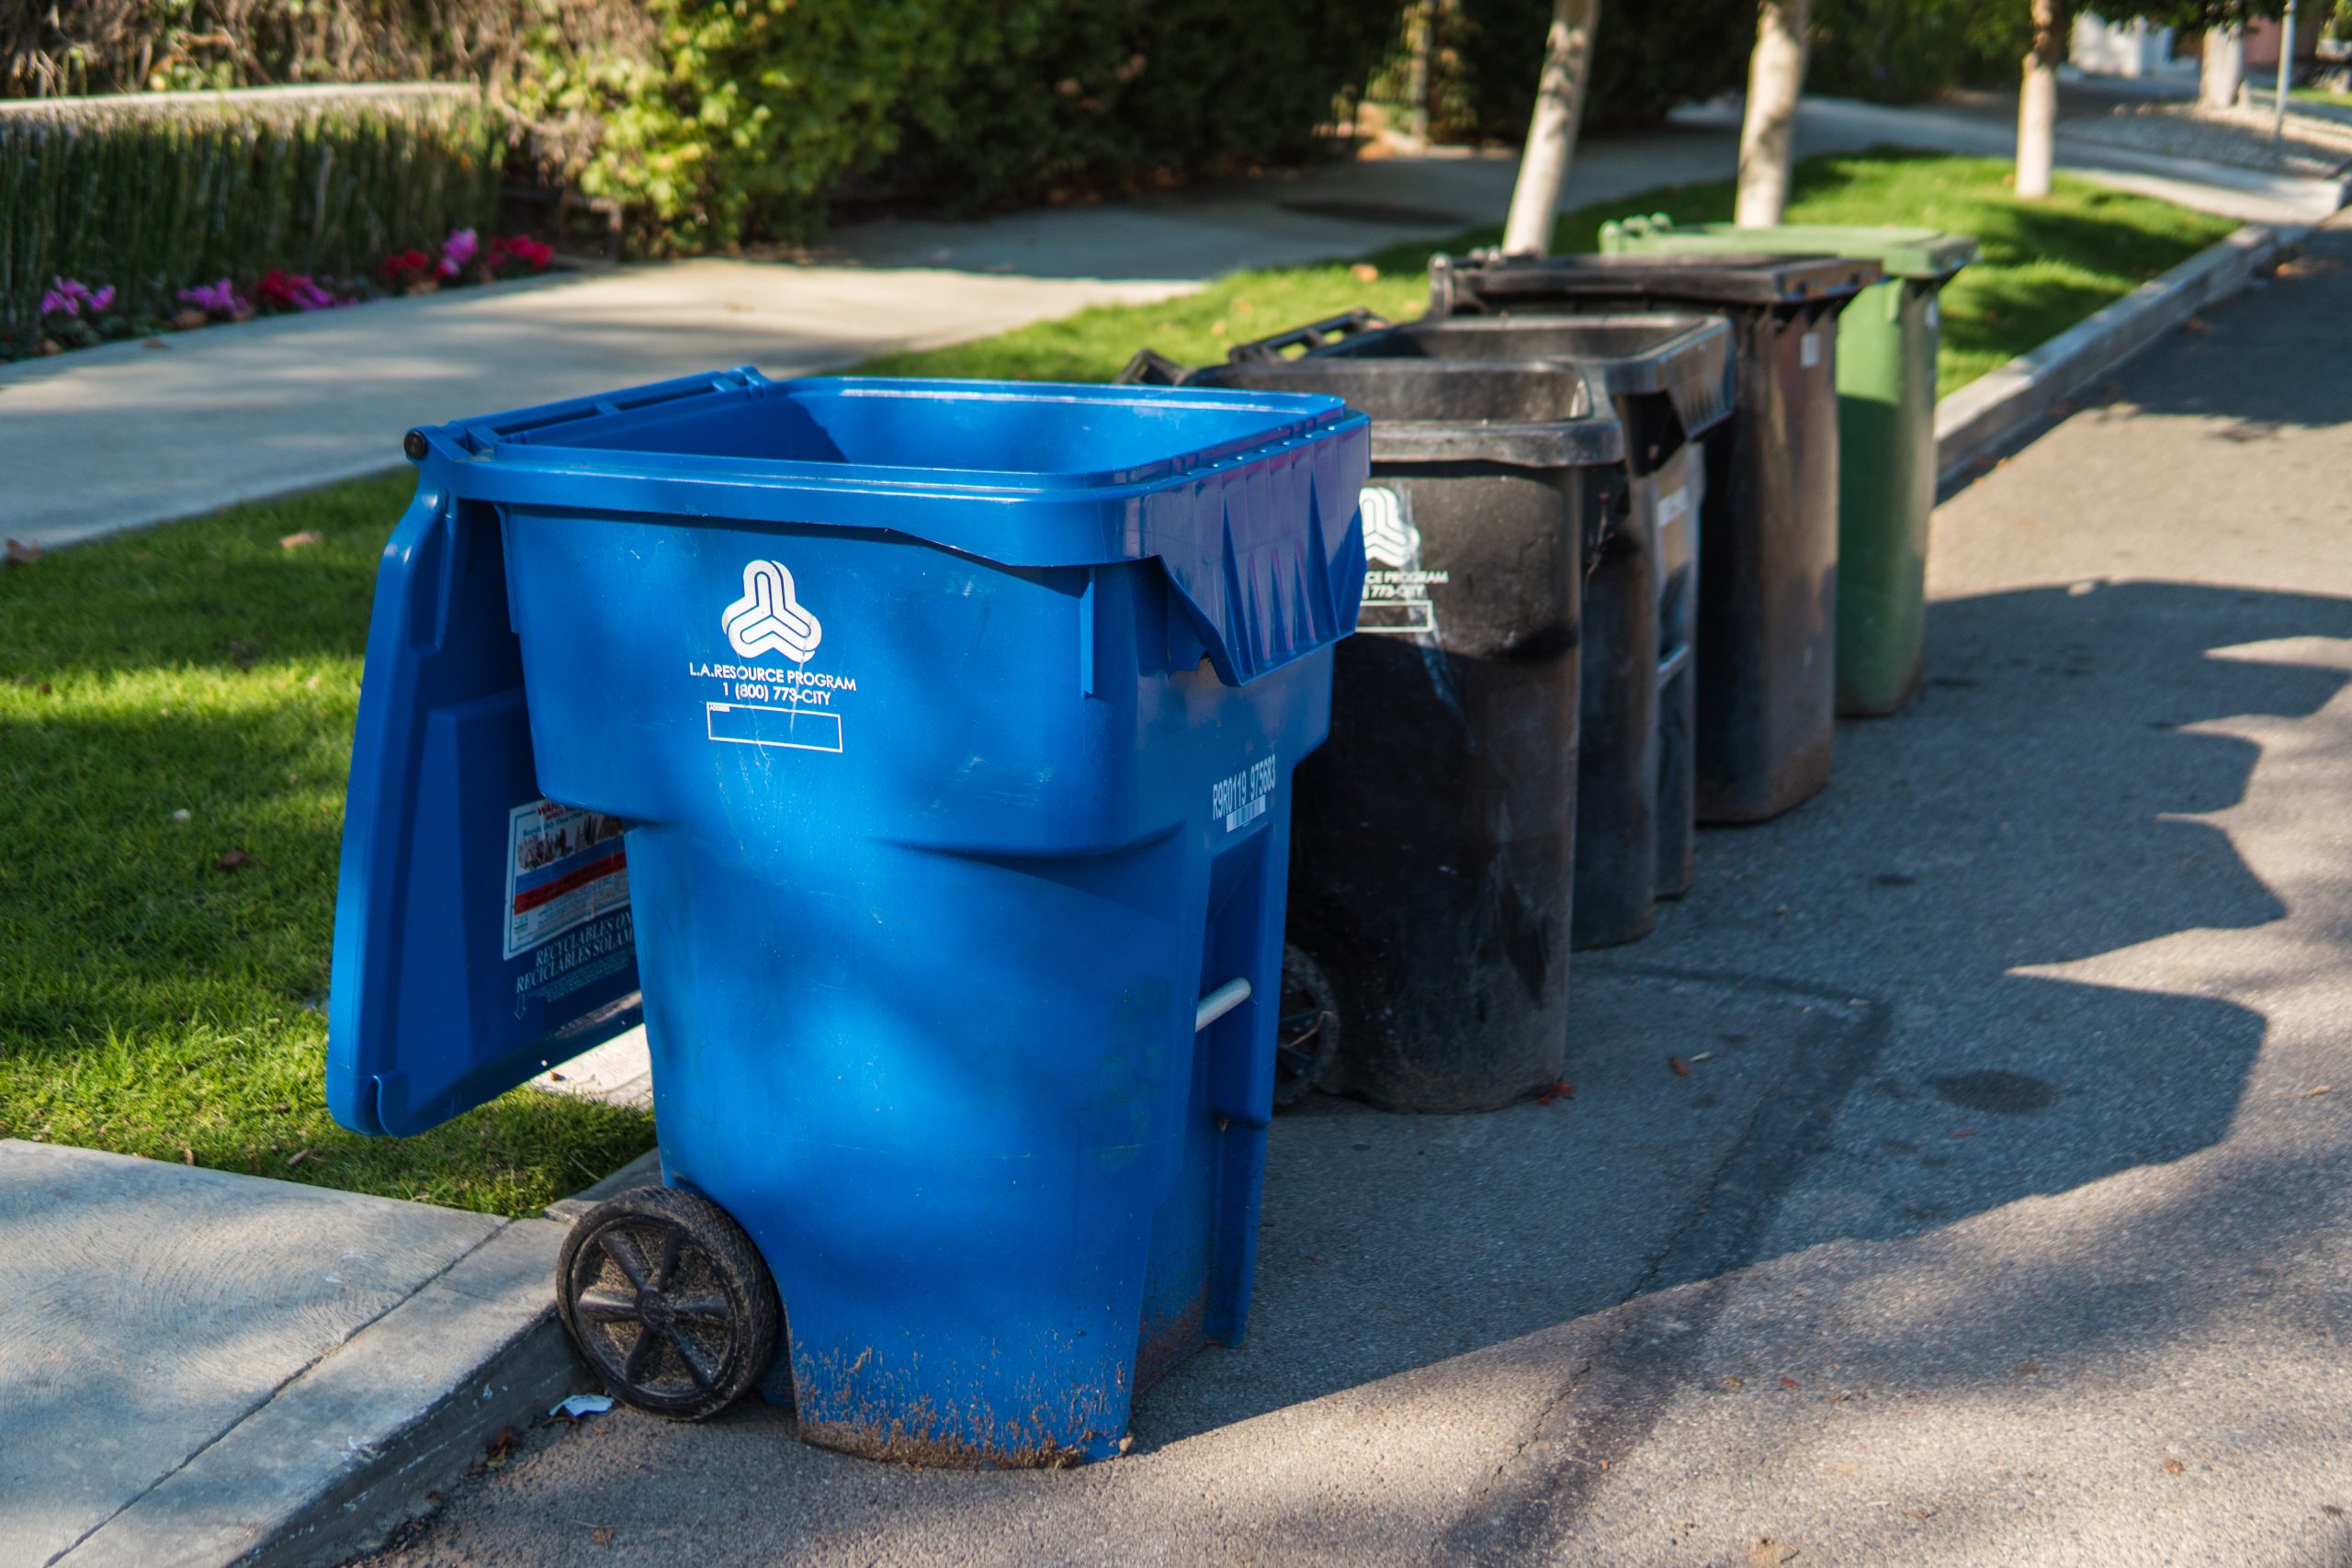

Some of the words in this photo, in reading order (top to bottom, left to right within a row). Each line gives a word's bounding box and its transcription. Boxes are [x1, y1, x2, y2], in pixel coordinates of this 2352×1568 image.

[1385, 570, 1449, 584] PROGRAM
[787, 670, 856, 692] PROGRAM
[723, 682, 729, 698] 1
[736, 682, 769, 702] (800)
[773, 686, 831, 705] 773-CITY
[537, 917, 613, 967] RECYCLABLES
